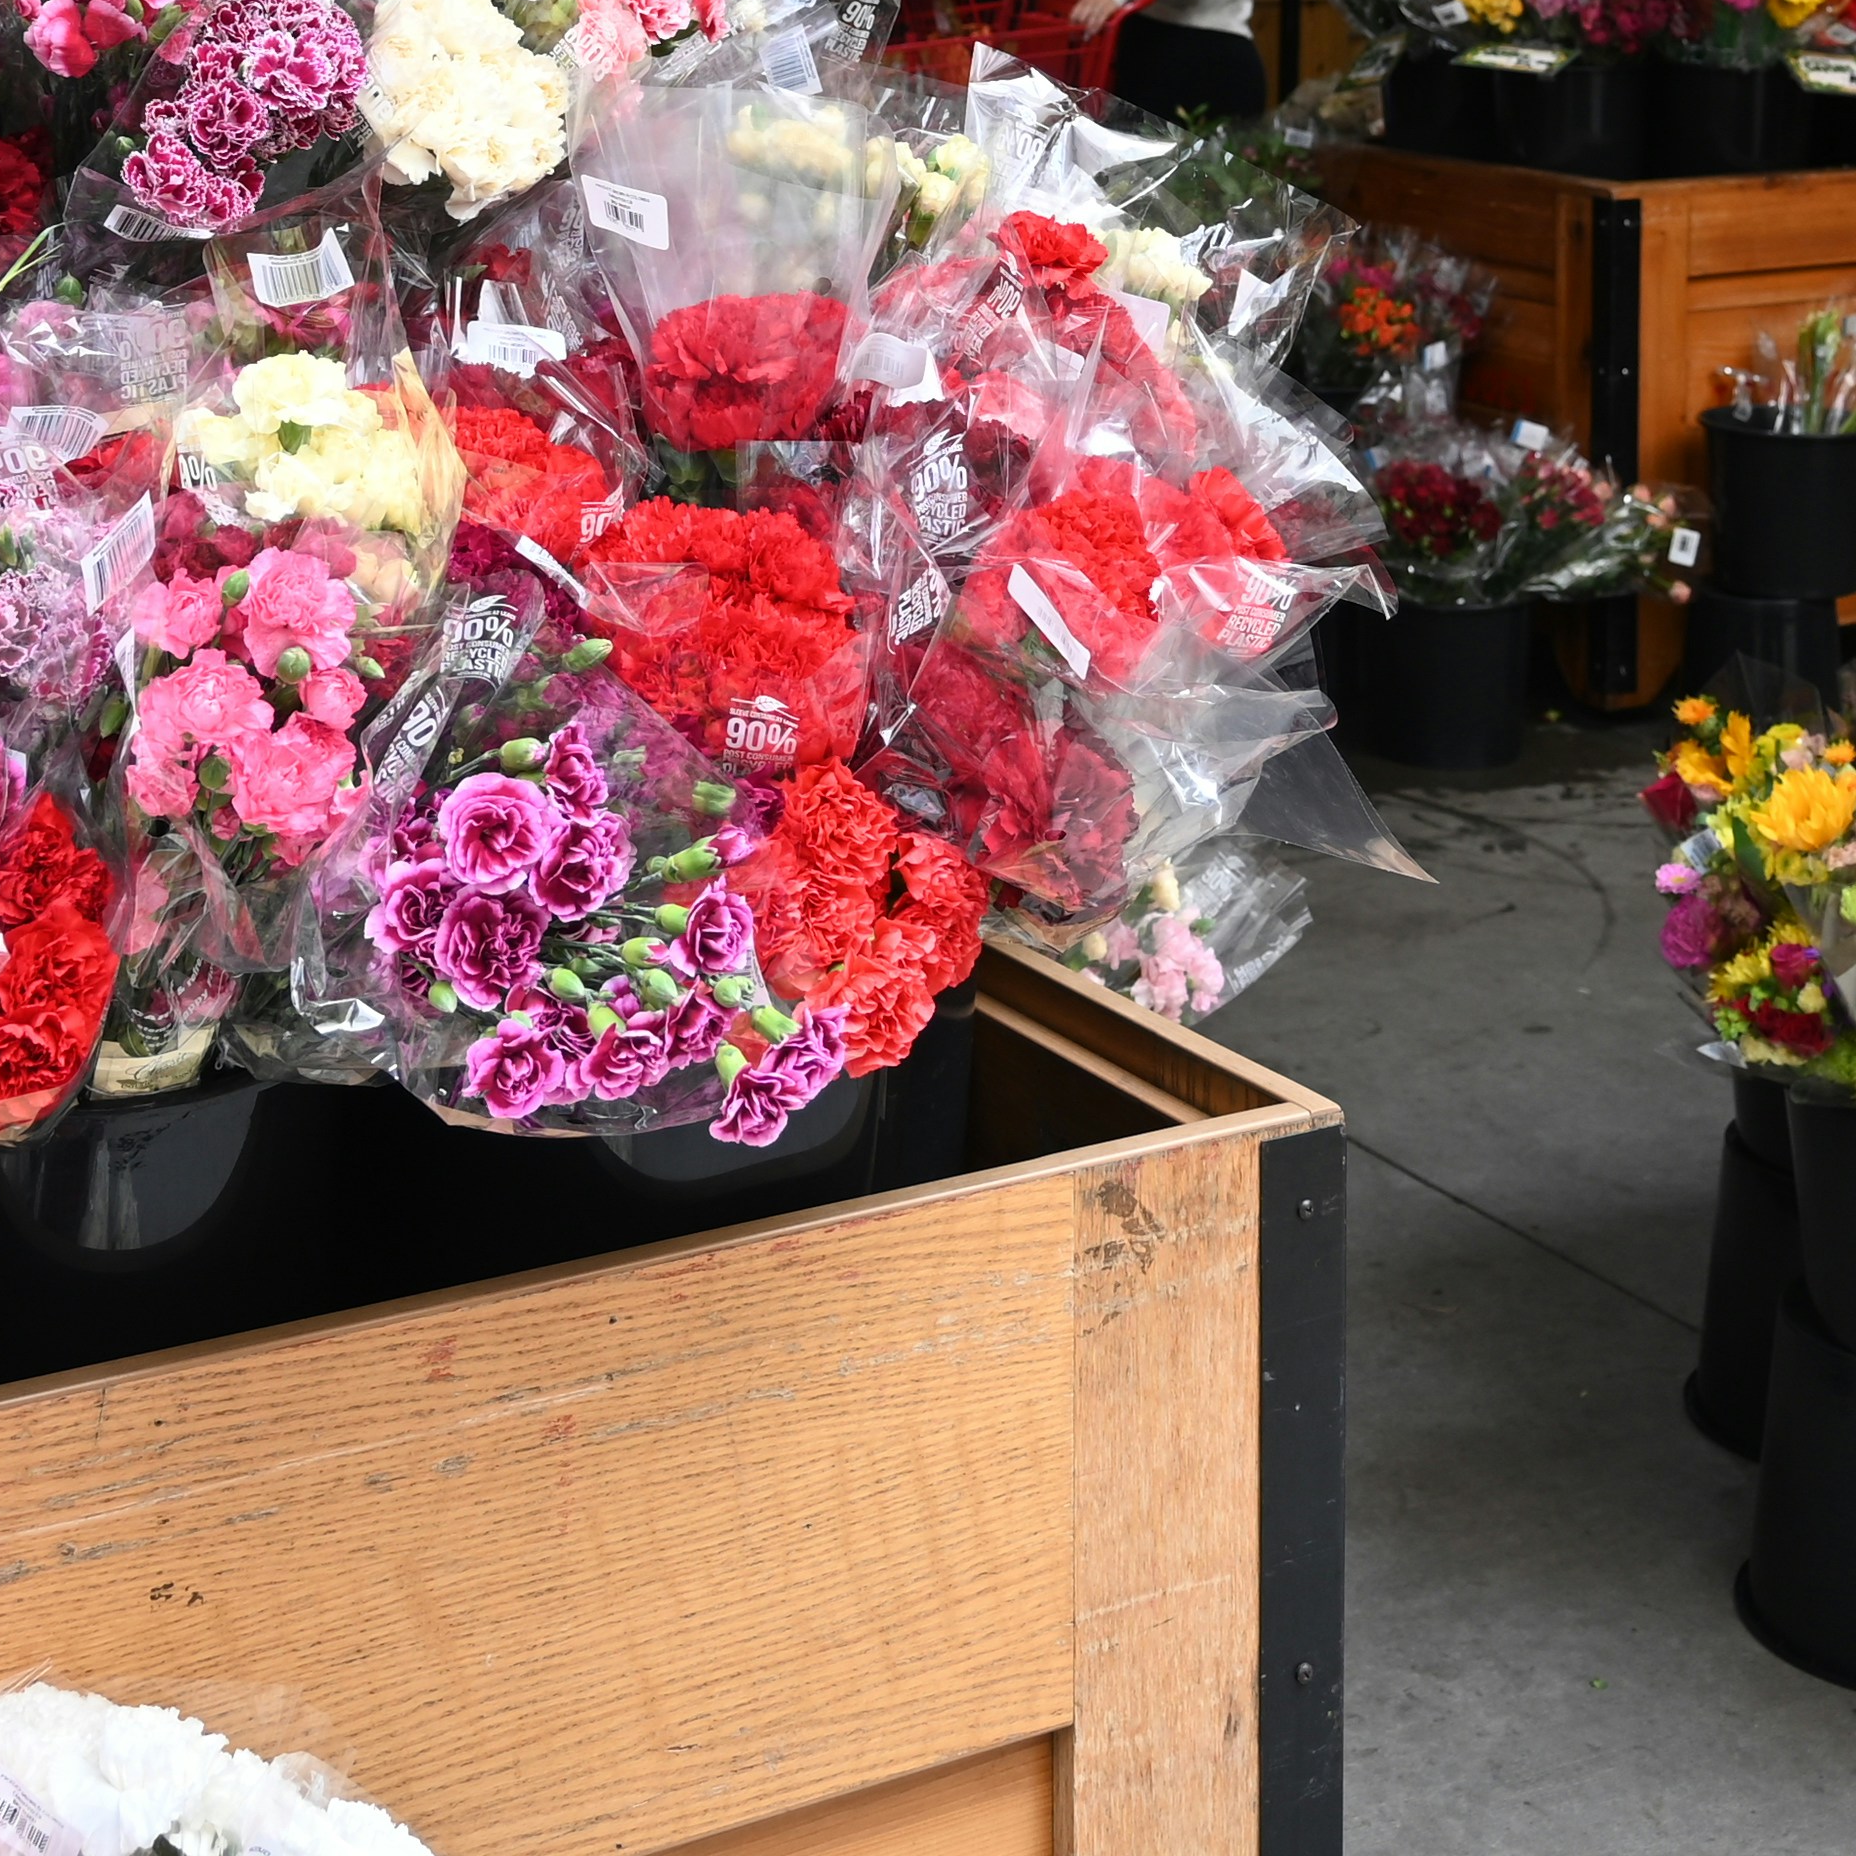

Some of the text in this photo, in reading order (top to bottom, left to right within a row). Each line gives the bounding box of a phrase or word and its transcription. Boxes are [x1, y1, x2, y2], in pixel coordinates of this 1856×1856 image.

[843, 1, 876, 30] 90%
[825, 38, 863, 63] PLASTIC
[830, 28, 869, 51] RECYCLED
[910, 454, 968, 502] 90%
[1241, 574, 1293, 611] 90%
[1226, 614, 1282, 637] RECYCLED
[1233, 604, 1287, 623] POST CONSUMER
[443, 616, 514, 648] 90%
[1216, 628, 1273, 649] PLASTIC
[726, 717, 797, 755] 90%
[723, 749, 794, 762] POST CONSUMER
